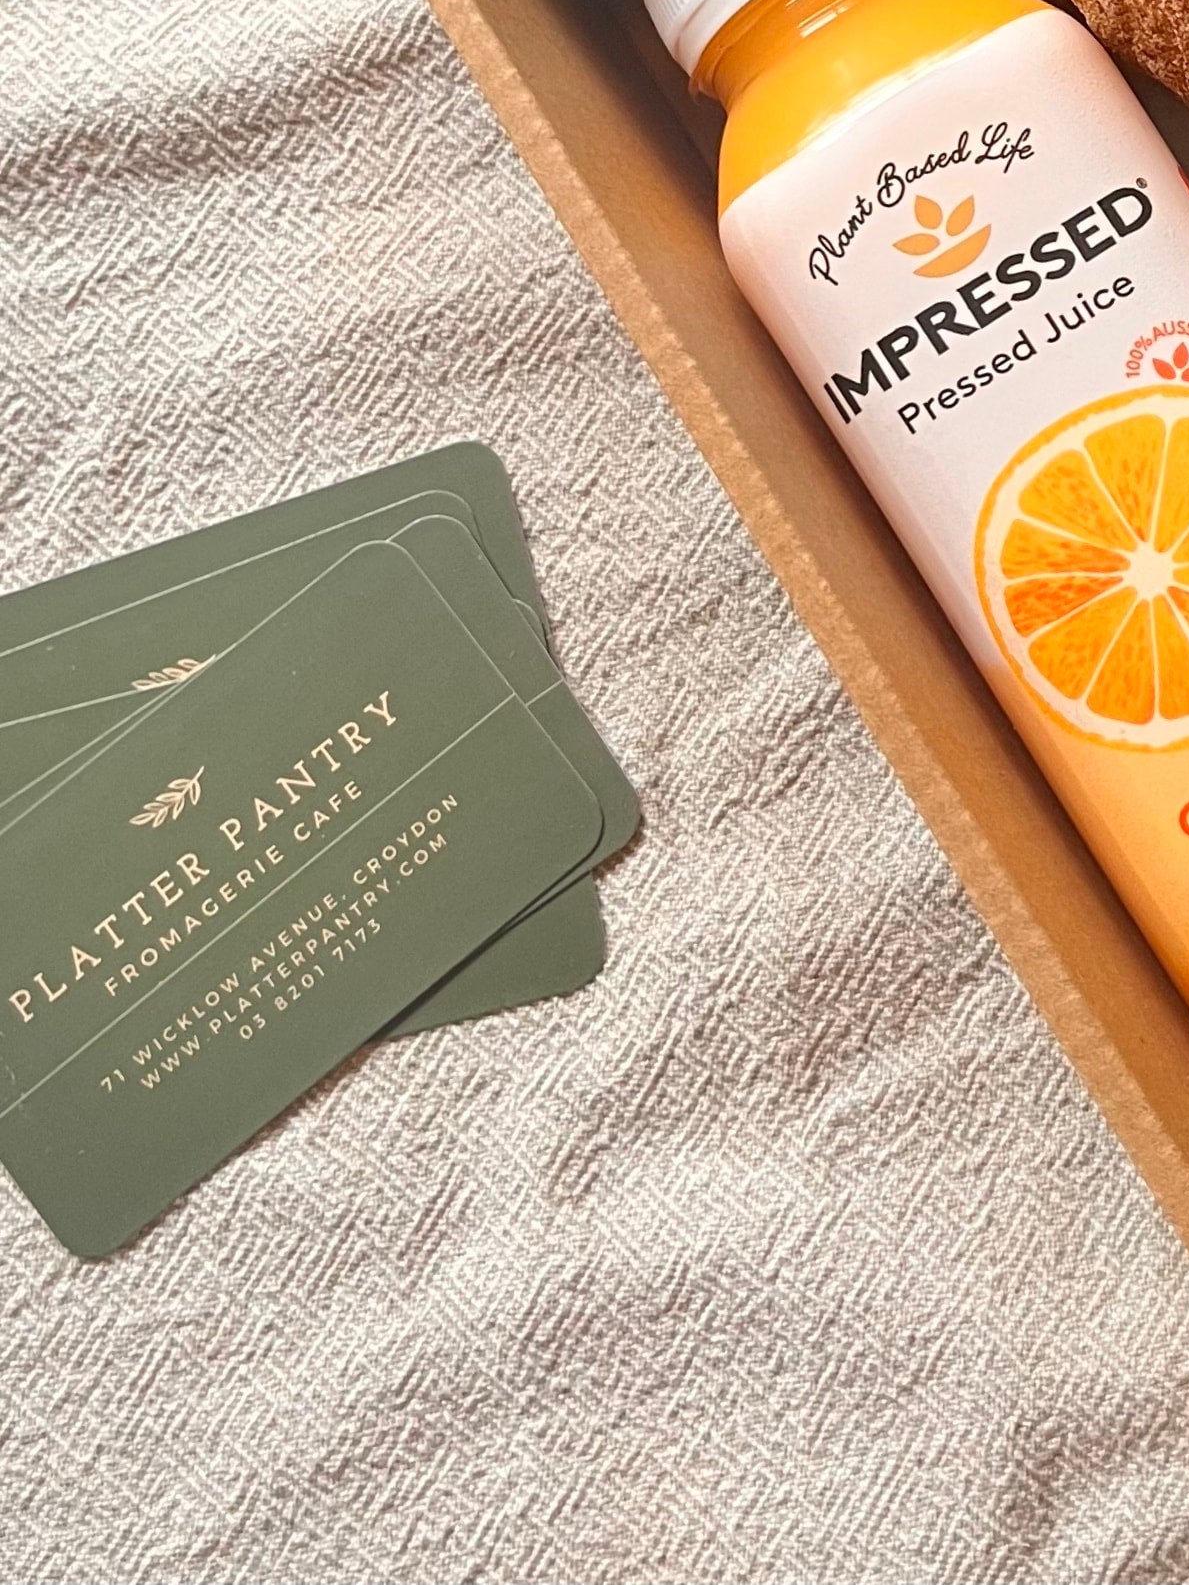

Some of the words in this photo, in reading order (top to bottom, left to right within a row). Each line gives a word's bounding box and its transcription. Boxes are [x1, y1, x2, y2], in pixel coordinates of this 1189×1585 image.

[808, 196, 874, 287] Plant
[876, 130, 973, 209] Based
[974, 121, 1036, 174] Life
[823, 186, 1154, 425] IMPRESSED
[897, 329, 1038, 434] Pressed
[1046, 275, 1136, 344] Juice
[1125, 335, 1153, 379] 100%
[8, 851, 211, 1024] PLATTER
[218, 690, 400, 852] PANTRY
[100, 1069, 126, 1093] 71
[132, 972, 240, 1066] WICKLOW
[352, 793, 459, 885] CROYDON
[104, 844, 285, 997] FROMAGERIE
[293, 780, 363, 842] CAFE
[140, 833, 448, 1090] WWW.PLATTERPANTRY.COM
[239, 1013, 267, 1040] 03
[274, 964, 326, 1011] 8201
[332, 917, 382, 962] 7173
